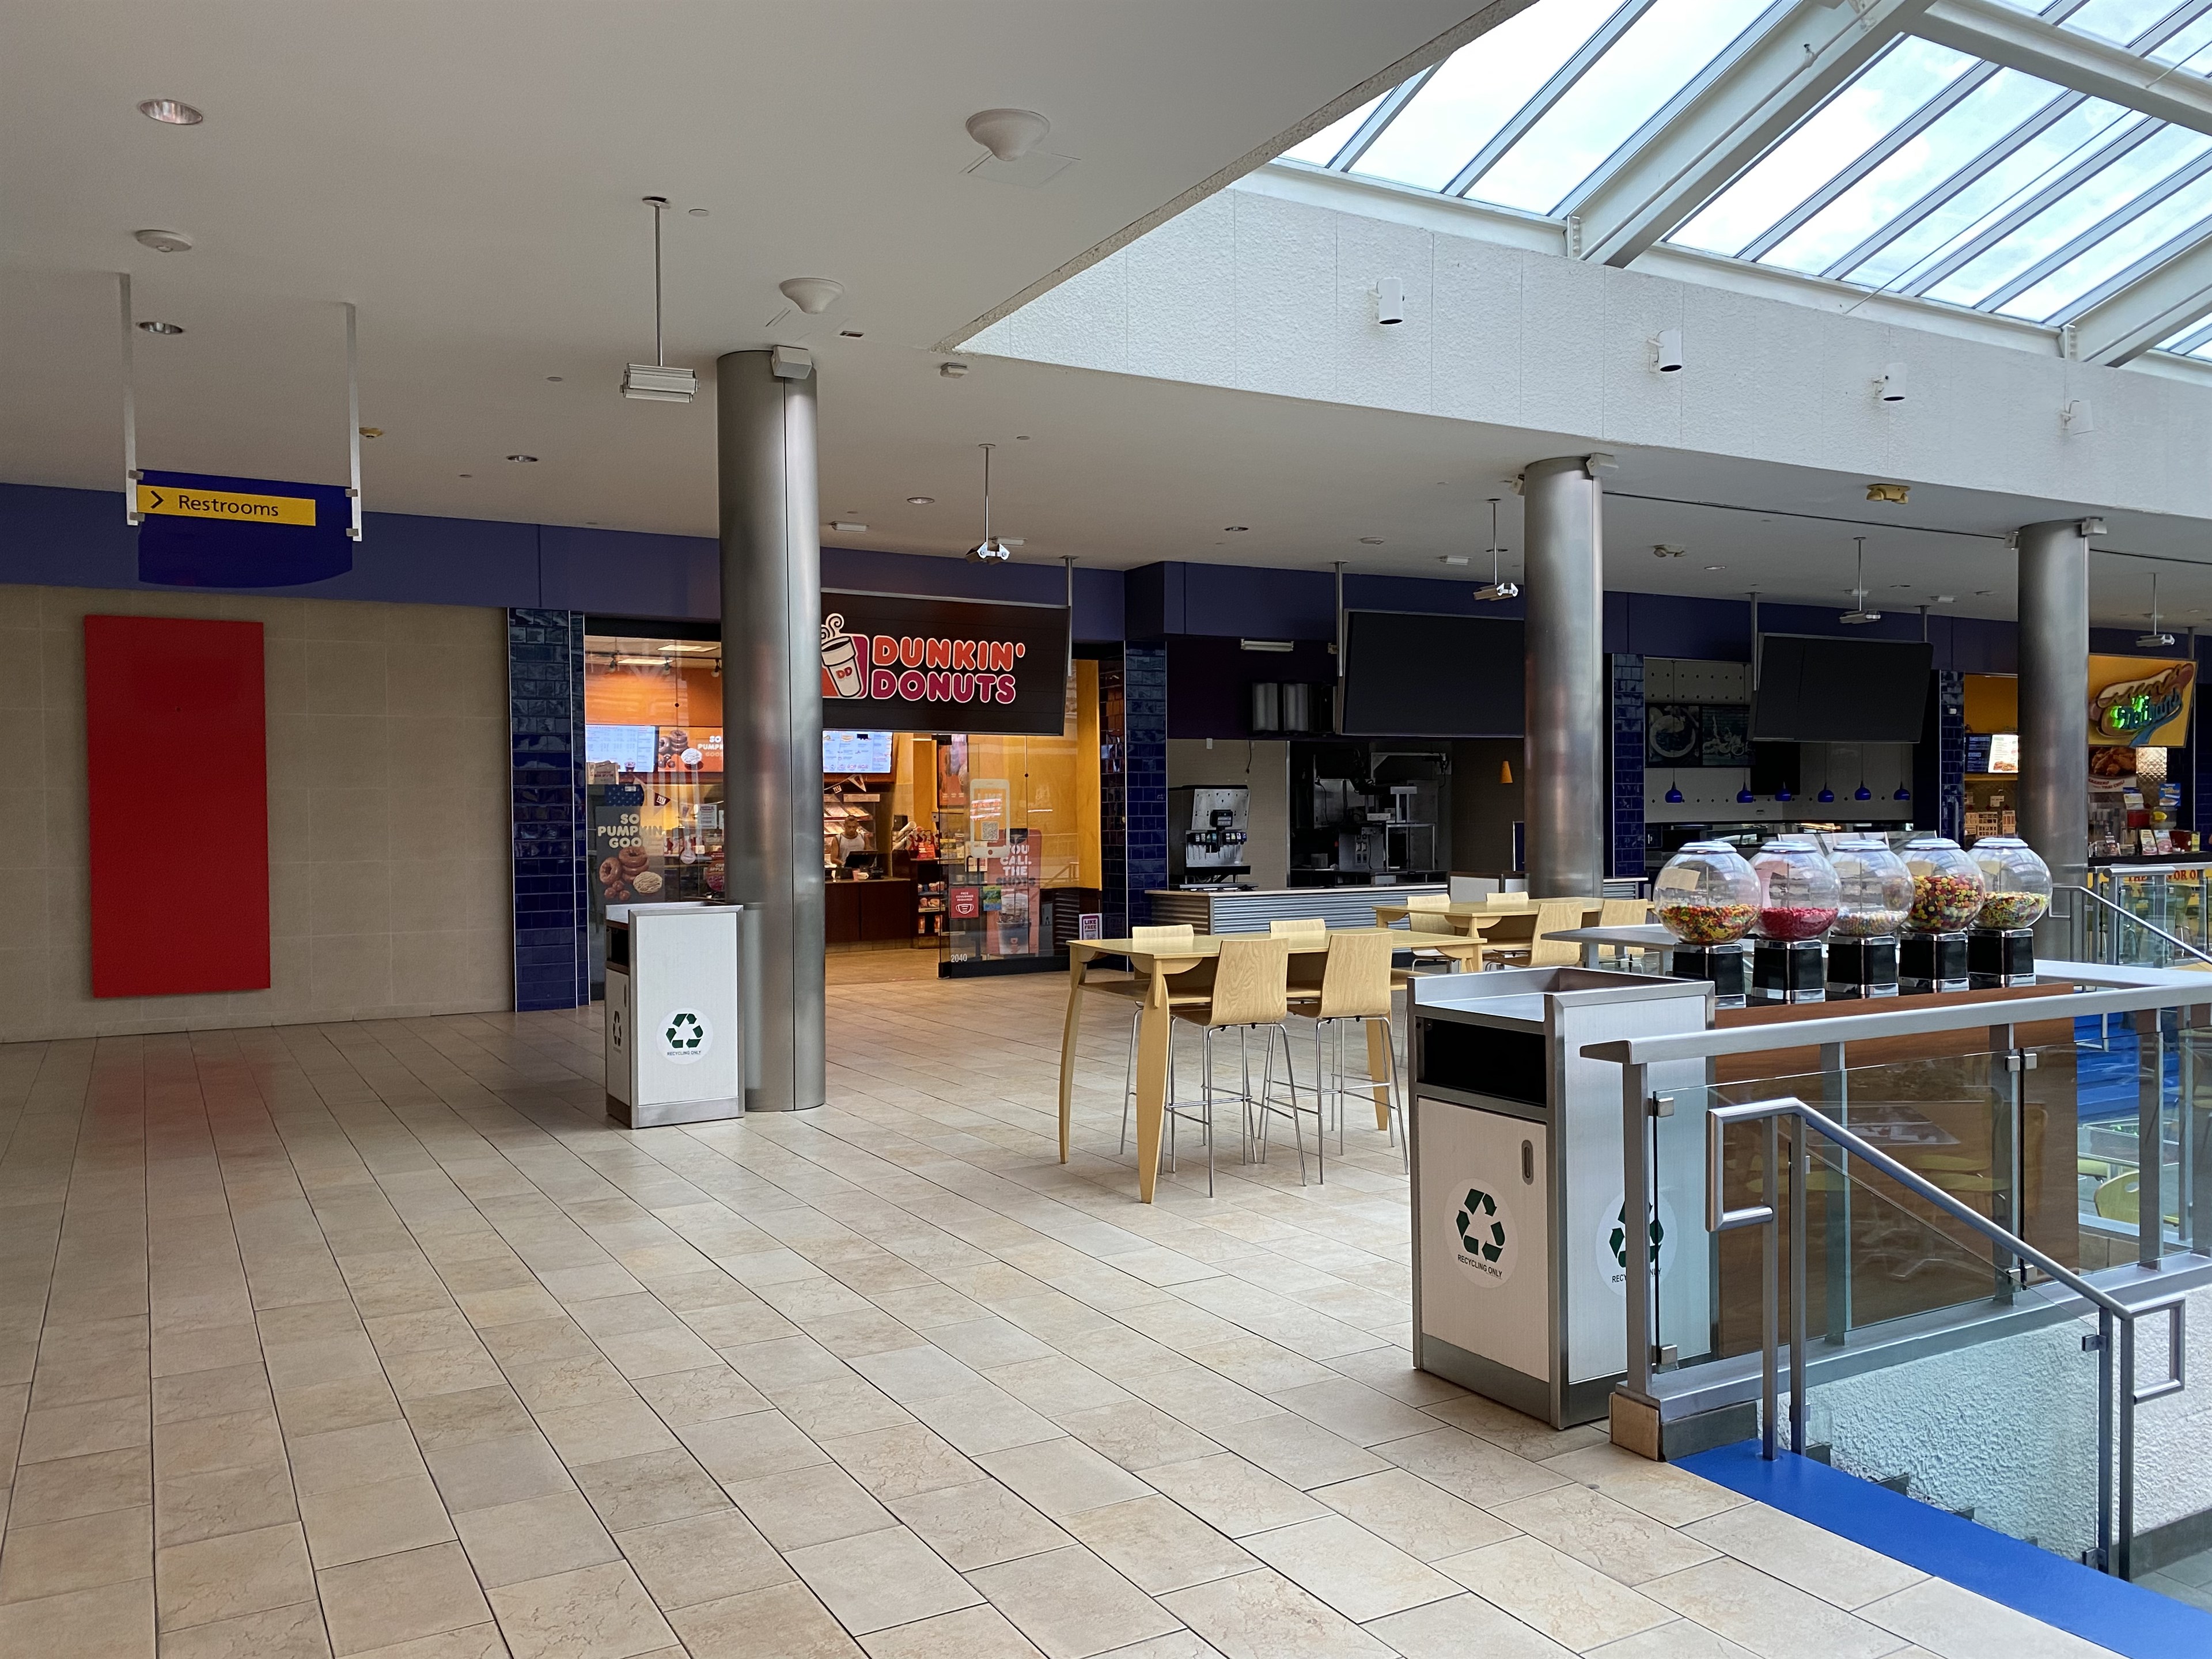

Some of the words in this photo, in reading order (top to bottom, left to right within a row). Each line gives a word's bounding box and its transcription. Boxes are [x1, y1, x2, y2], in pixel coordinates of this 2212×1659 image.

[179, 495, 279, 517] Restrooms
[872, 635, 1025, 671] DUNKIN'
[836, 666, 853, 679] DD
[871, 669, 1016, 704] DONUTS
[620, 813, 640, 824] SO
[597, 825, 662, 836] PUMPKIN
[608, 837, 642, 849] GOO
[1000, 855, 1032, 865] CALL
[1002, 866, 1028, 876] THE
[950, 953, 967, 963] 2040
[1457, 1254, 1487, 1272] RECYCLING
[1488, 1266, 1502, 1278] ONLY
